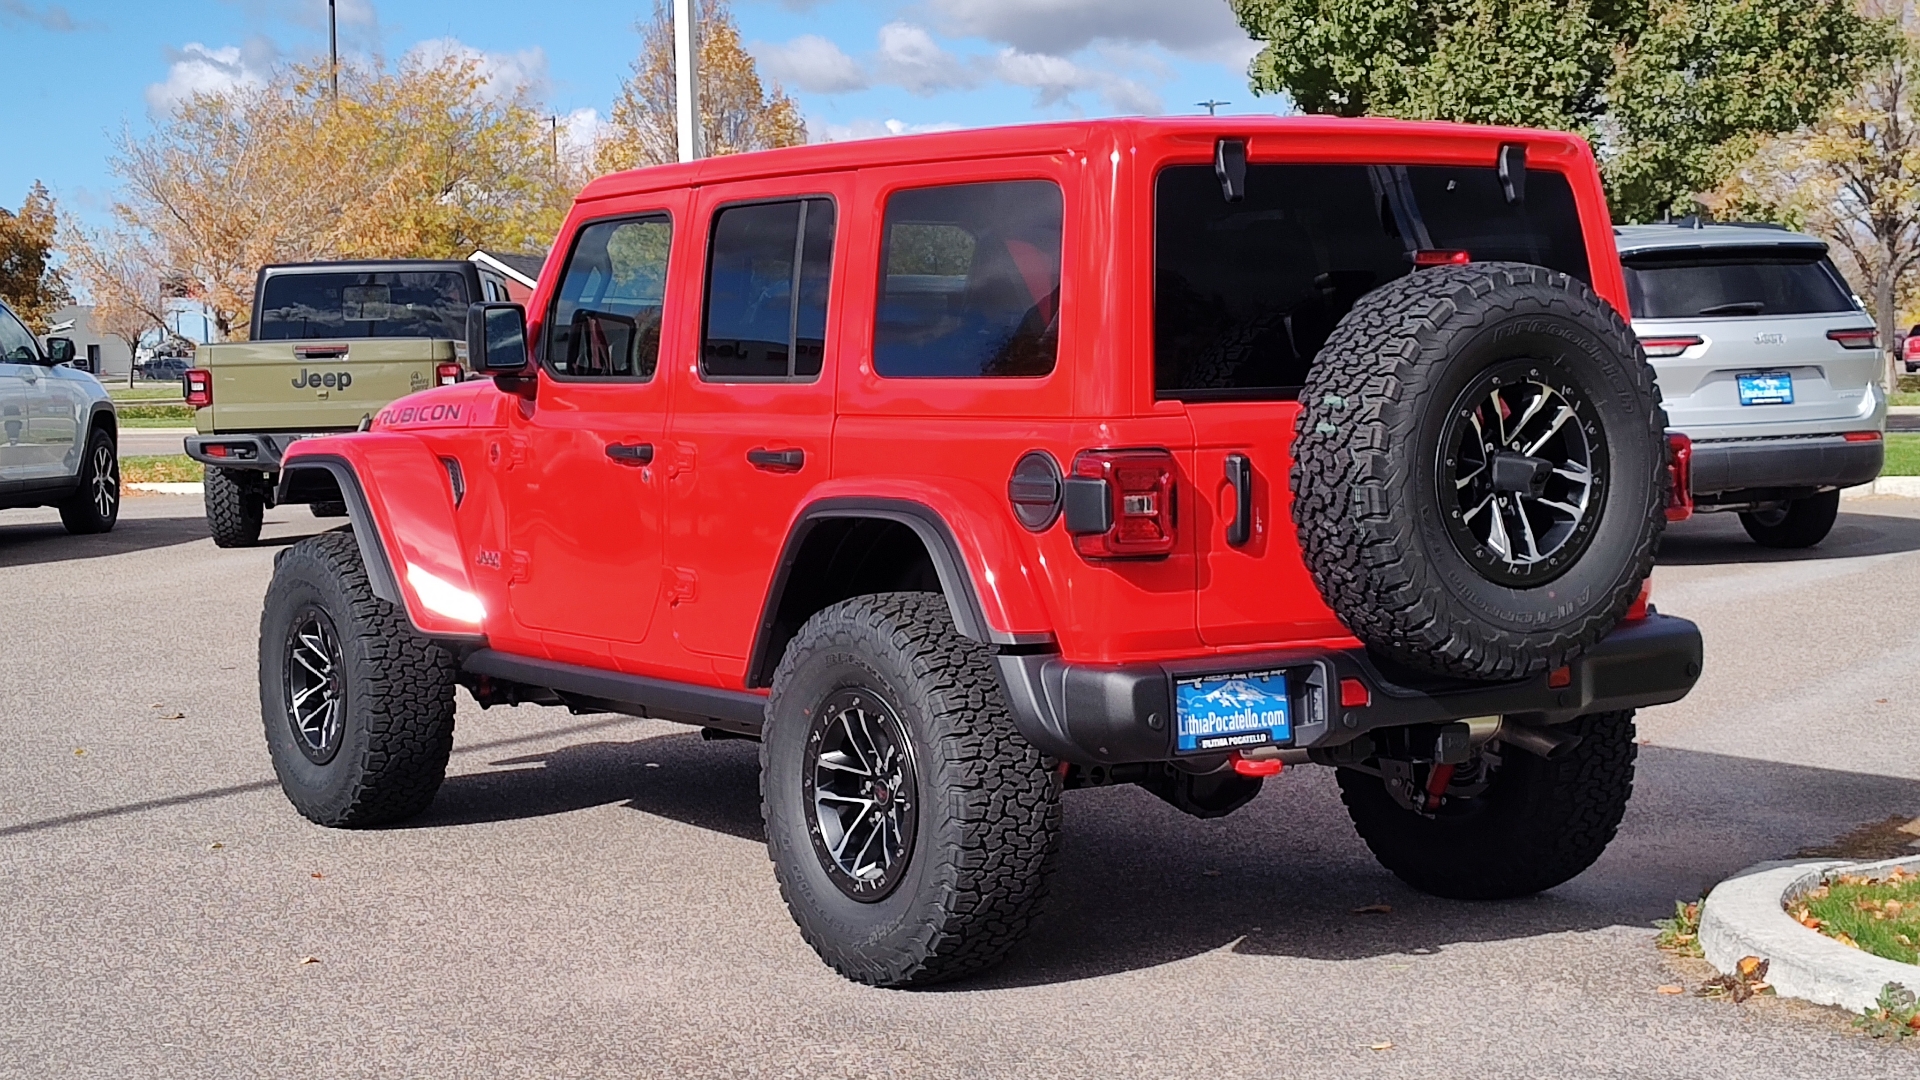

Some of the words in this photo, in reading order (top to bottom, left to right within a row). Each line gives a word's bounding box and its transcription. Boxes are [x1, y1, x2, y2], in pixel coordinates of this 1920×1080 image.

[291, 368, 352, 391] Jeep
[378, 404, 462, 426] RUBICON
[1177, 708, 1285, 736] LithiaPocatello.com
[1228, 733, 1267, 746] POCATELLO
